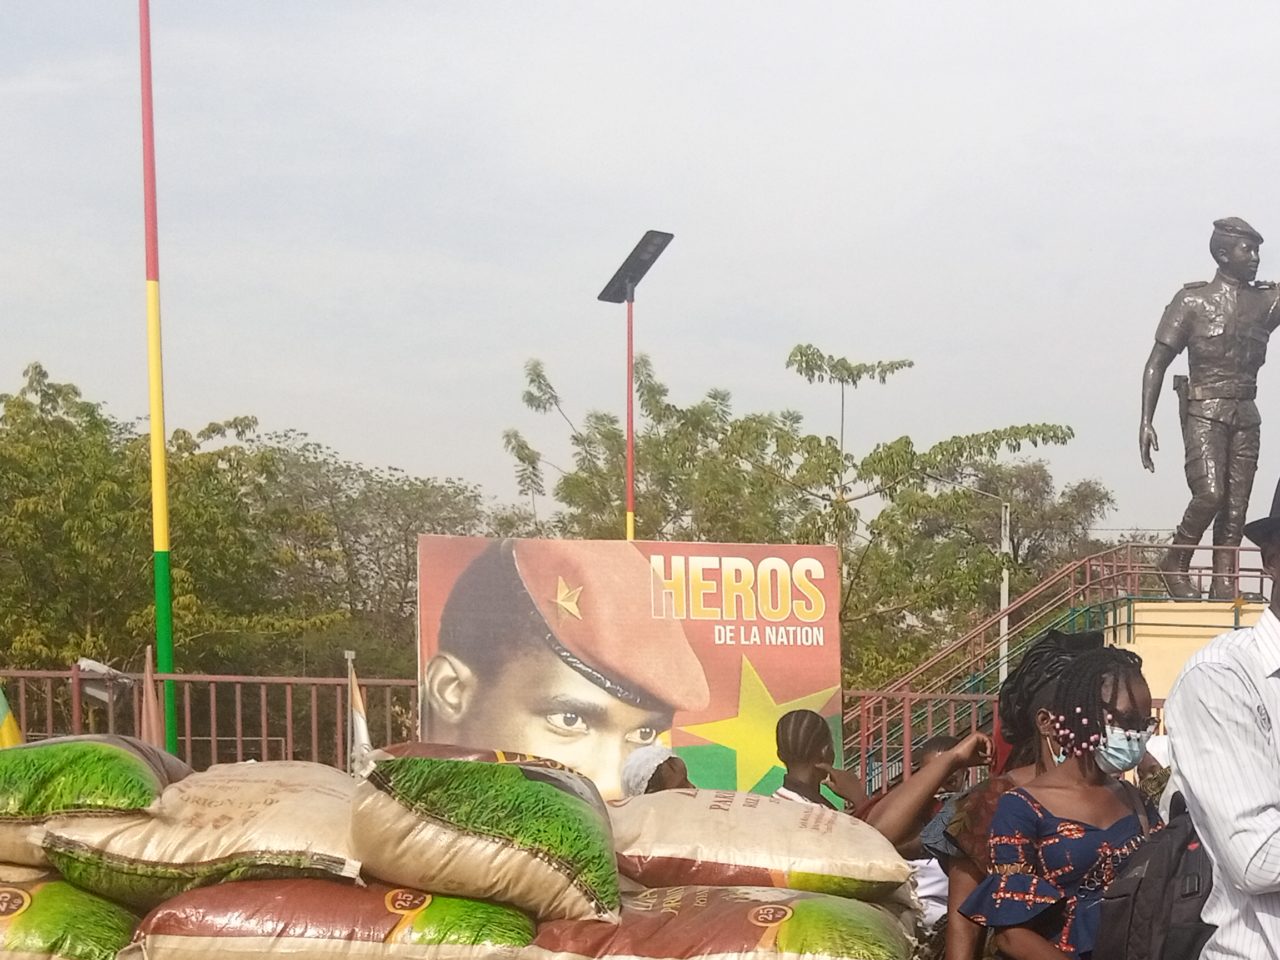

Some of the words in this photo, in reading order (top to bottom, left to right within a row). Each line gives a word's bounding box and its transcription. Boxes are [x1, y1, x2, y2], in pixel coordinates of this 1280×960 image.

[650, 555, 826, 623] HEROS
[714, 625, 736, 645] DE
[740, 626, 761, 646] LA
[765, 626, 824, 646] NATION
[395, 893, 413, 909] 25
[758, 907, 775, 921] 25
